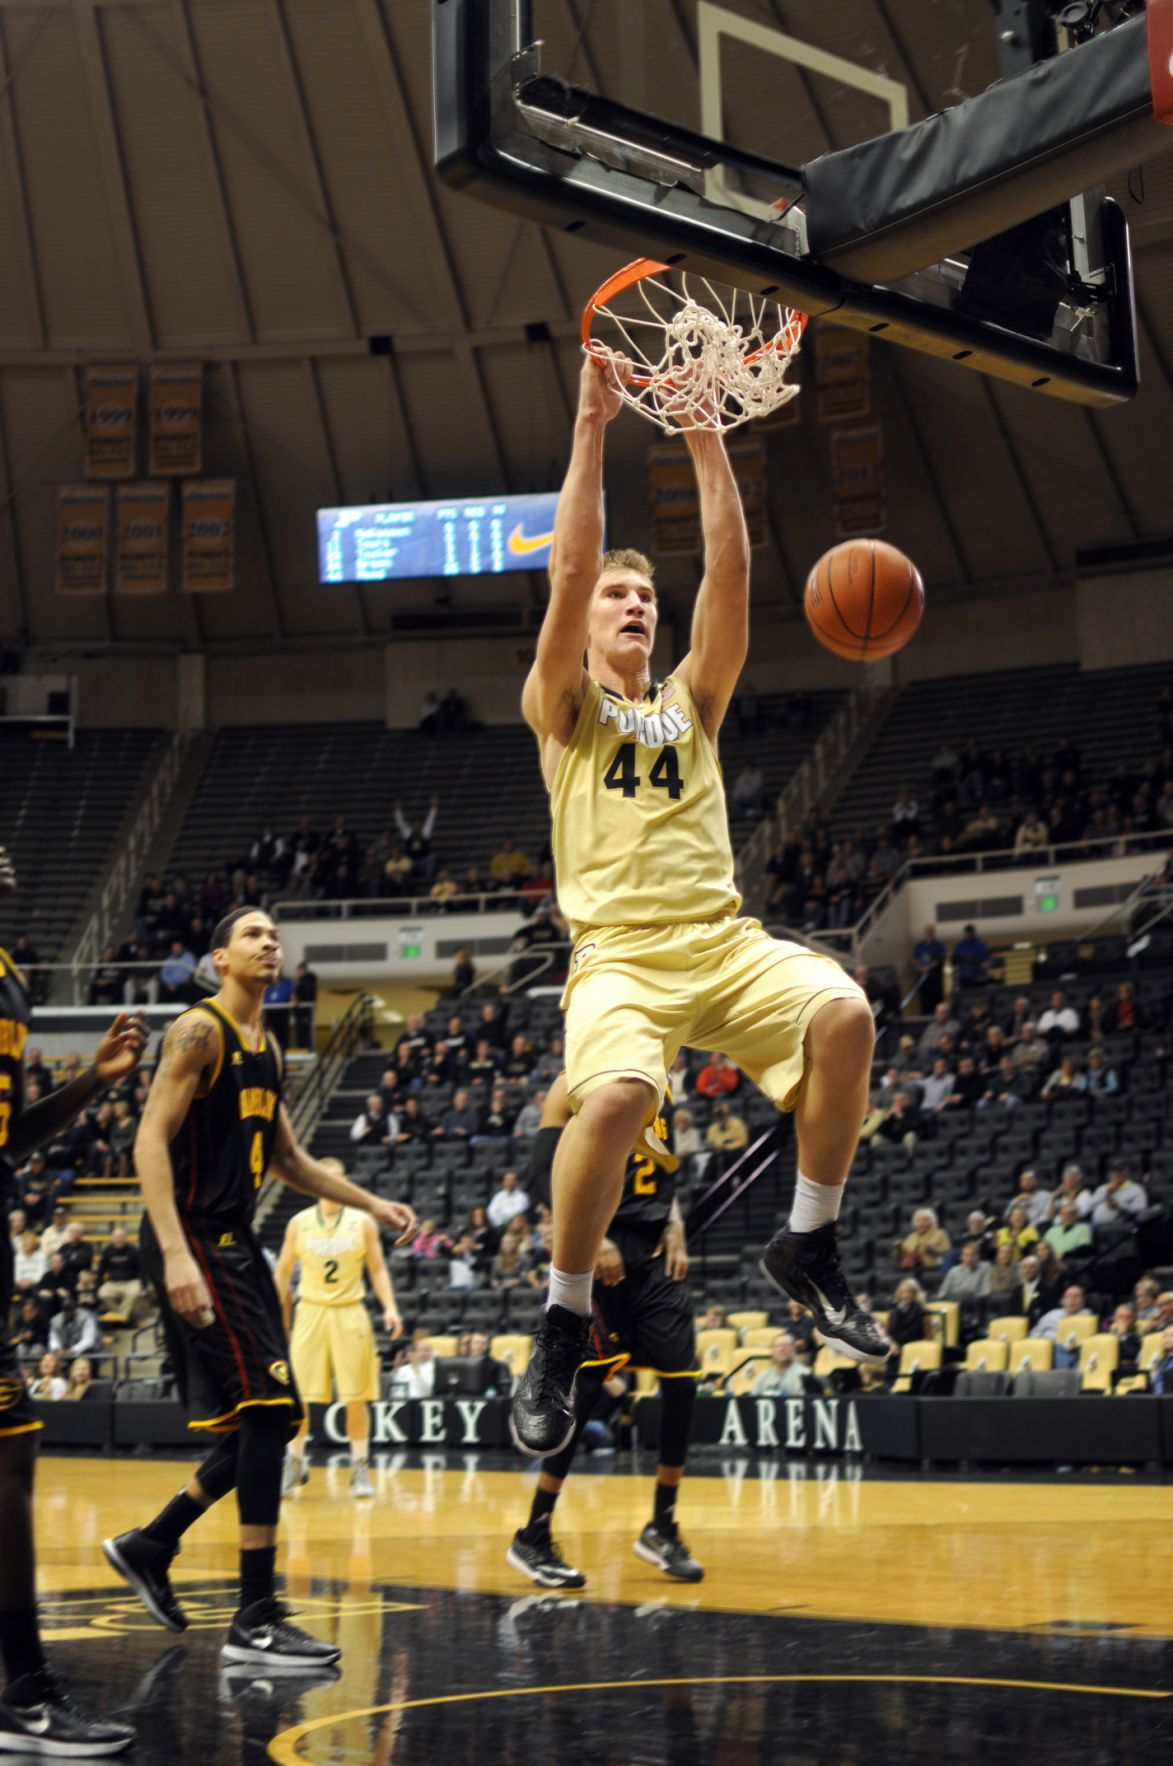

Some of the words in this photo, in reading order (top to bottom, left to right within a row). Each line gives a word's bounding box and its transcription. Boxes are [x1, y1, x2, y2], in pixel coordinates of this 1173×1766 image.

[598, 698, 693, 748] PURDUE
[603, 743, 684, 800] 44
[249, 1130, 264, 1190] 4
[323, 1259, 339, 1284] 2
[306, 1400, 487, 1443] CKEY
[718, 1397, 863, 1451] ARENA
